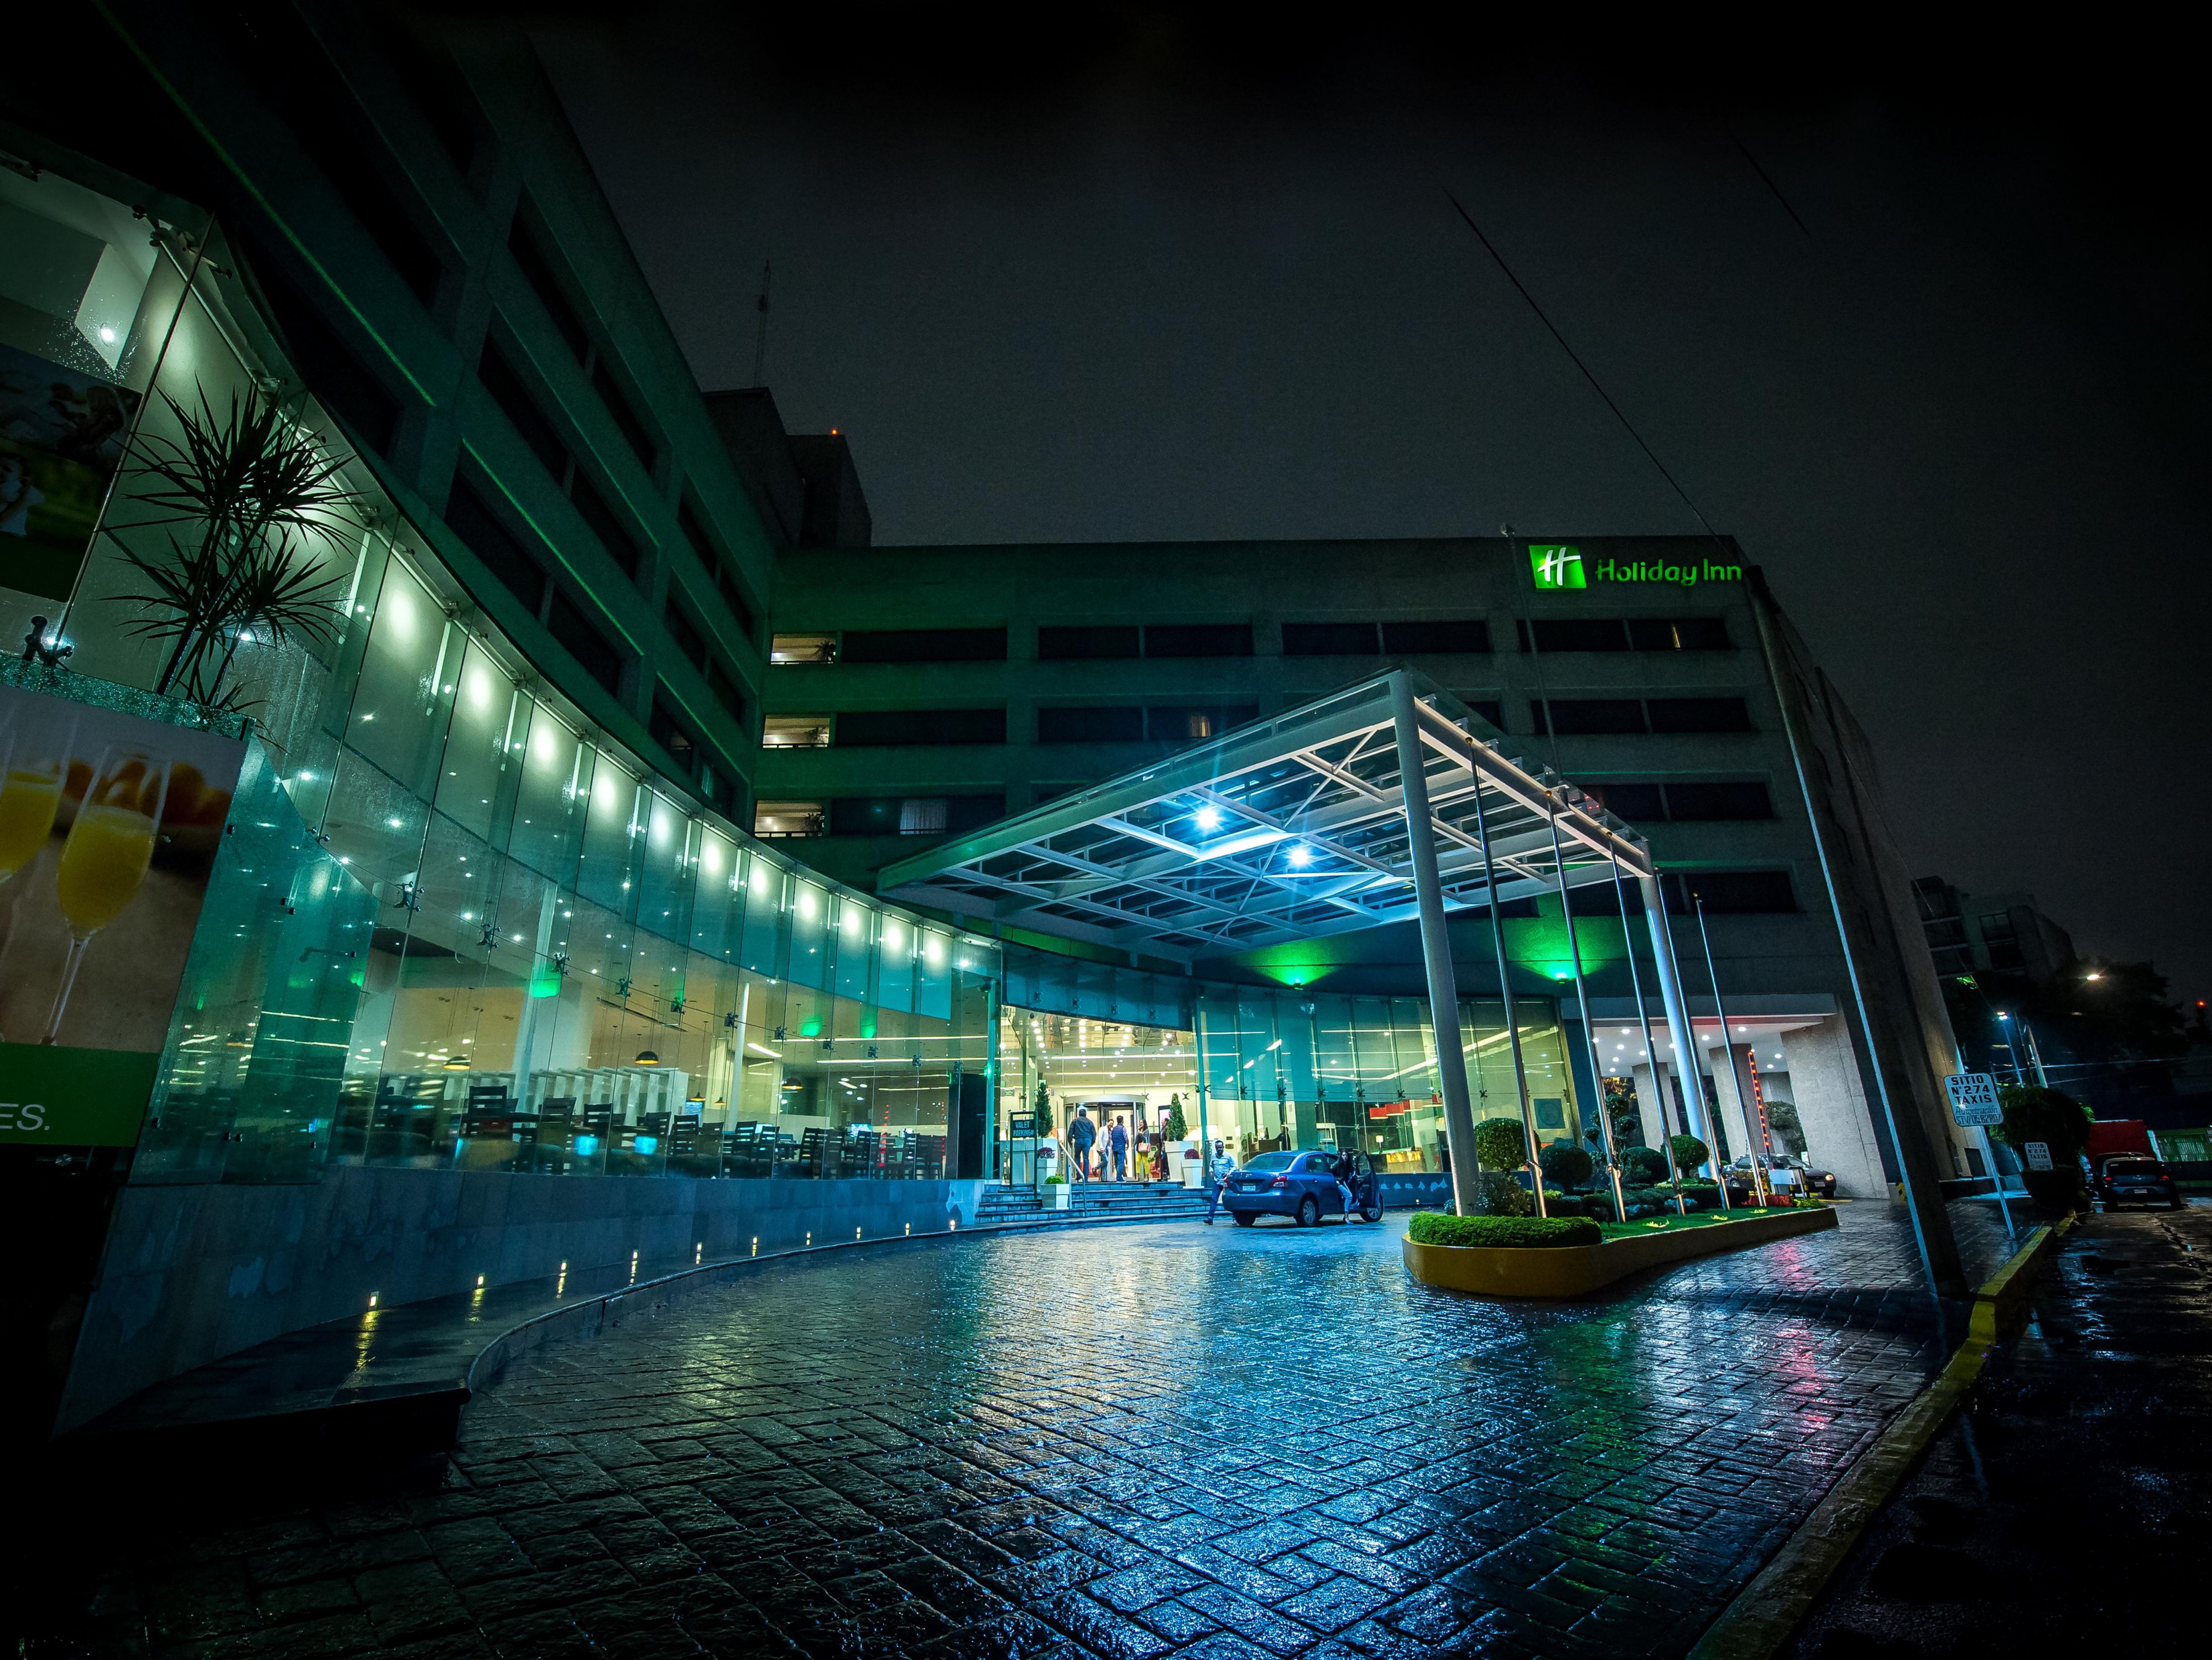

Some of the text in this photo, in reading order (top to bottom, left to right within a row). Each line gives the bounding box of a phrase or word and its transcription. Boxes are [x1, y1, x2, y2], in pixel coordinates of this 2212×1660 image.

[1595, 558, 1741, 586] Holiday Inn
[1951, 1075, 1984, 1085] SITIO
[1955, 1095, 1991, 1104] TAXIS
